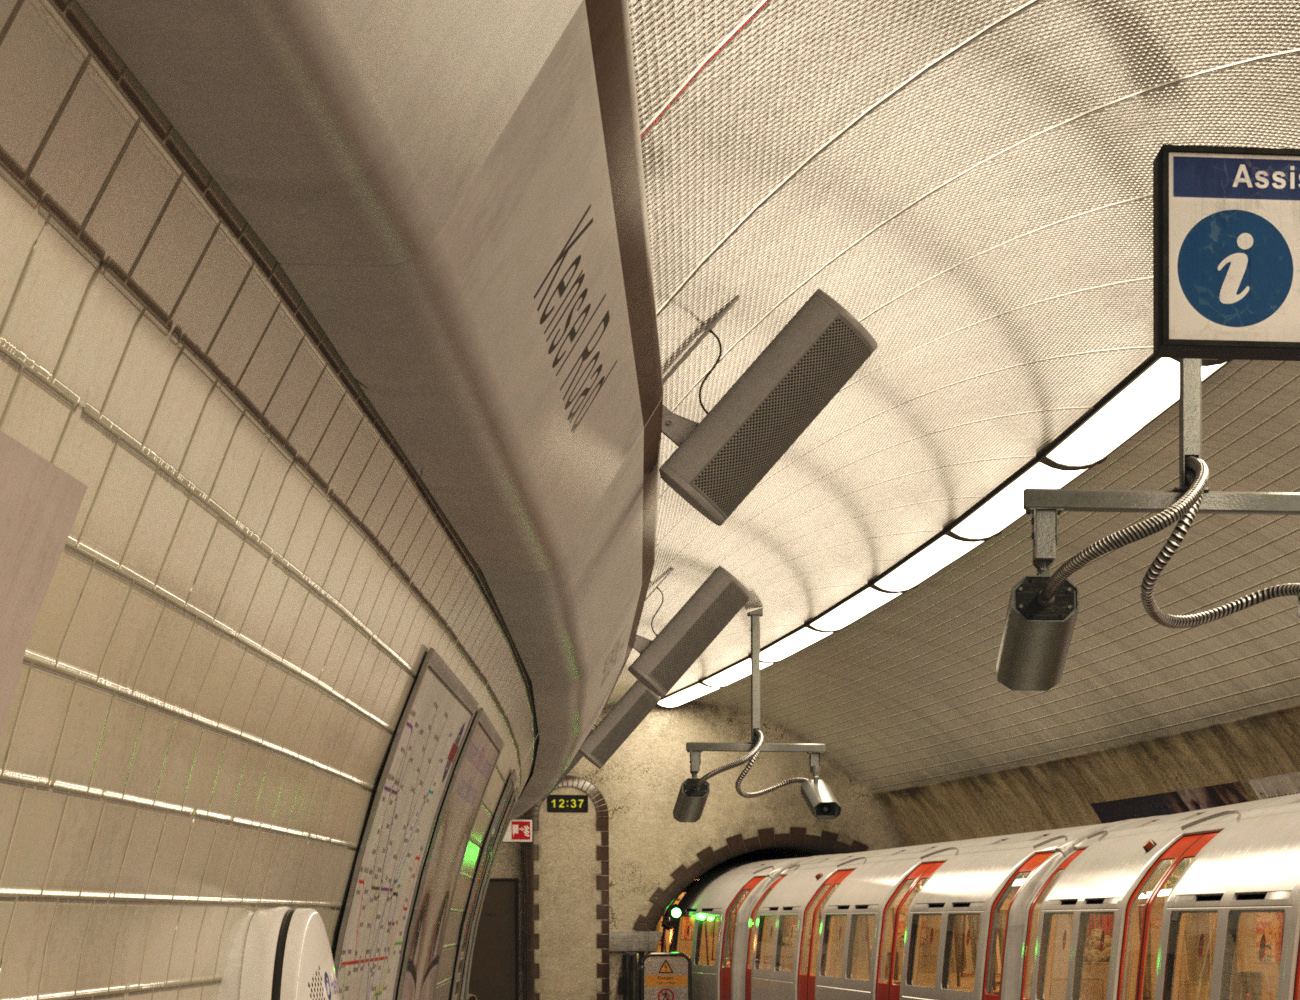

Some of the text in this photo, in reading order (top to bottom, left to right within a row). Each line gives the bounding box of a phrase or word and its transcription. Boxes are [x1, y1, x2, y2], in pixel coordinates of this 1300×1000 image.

[533, 204, 618, 433] Kensel Road
[551, 798, 585, 809] 12:37
